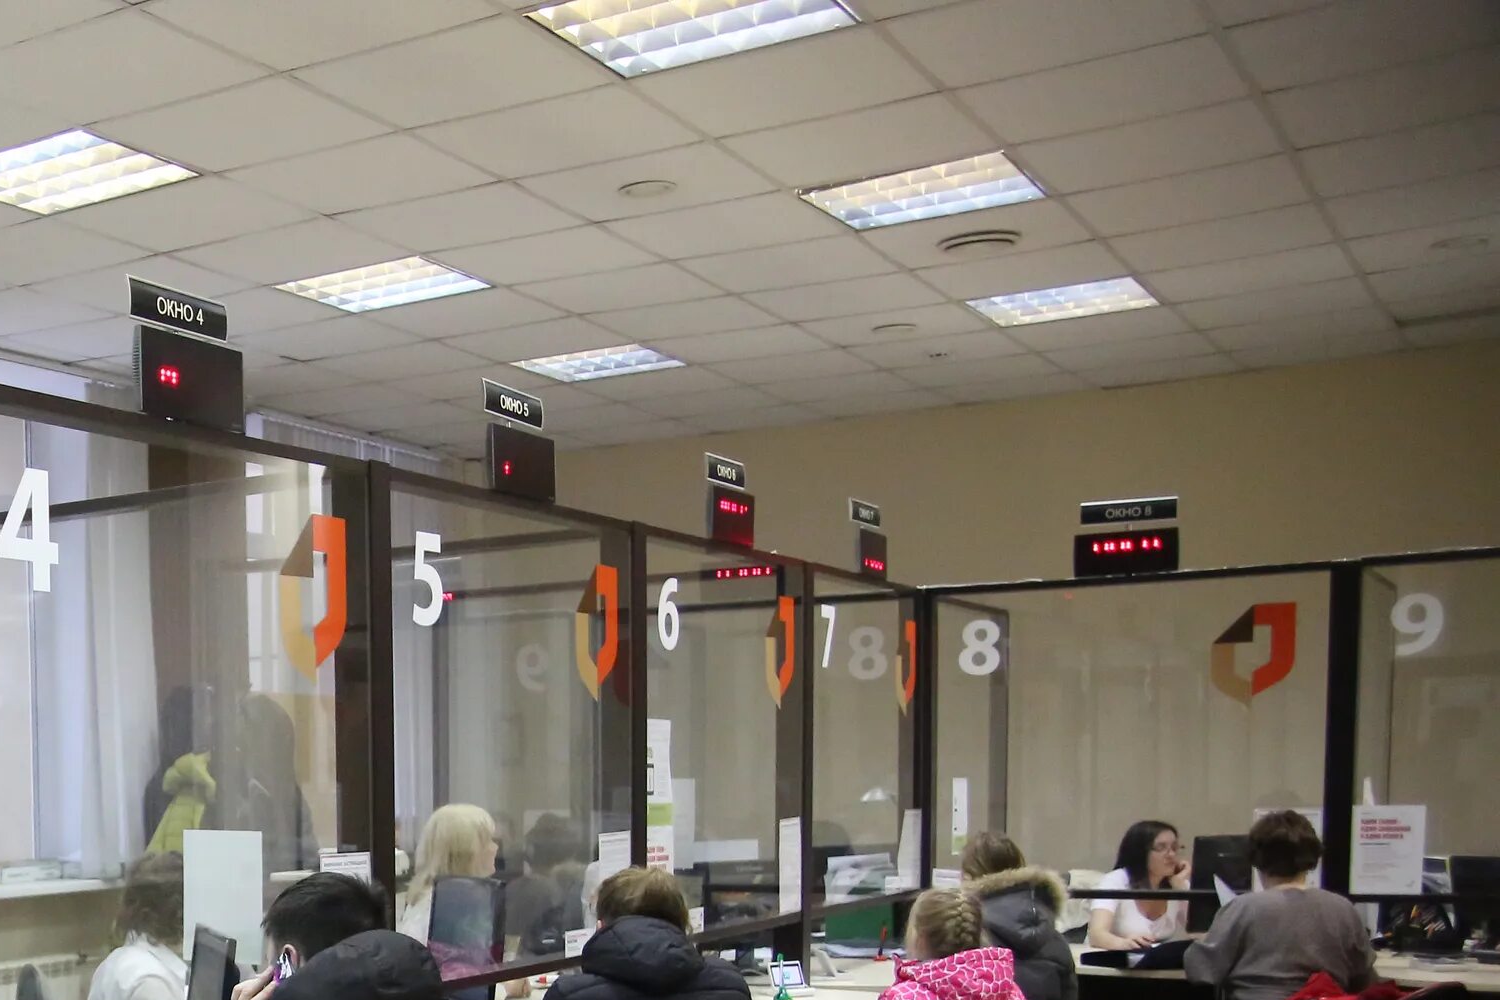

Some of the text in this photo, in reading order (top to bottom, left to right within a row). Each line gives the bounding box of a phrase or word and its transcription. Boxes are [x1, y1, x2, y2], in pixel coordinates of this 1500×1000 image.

[156, 296, 204, 325] ОКНО 4
[500, 394, 529, 417] ОКНО 5
[717, 464, 732, 480] ОКНО
[1105, 505, 1152, 519] ОКНО 8
[413, 531, 443, 627] 5
[658, 577, 679, 651] 6
[821, 604, 836, 668] 7
[1390, 592, 1444, 656] 9
[958, 619, 1000, 676] 8
